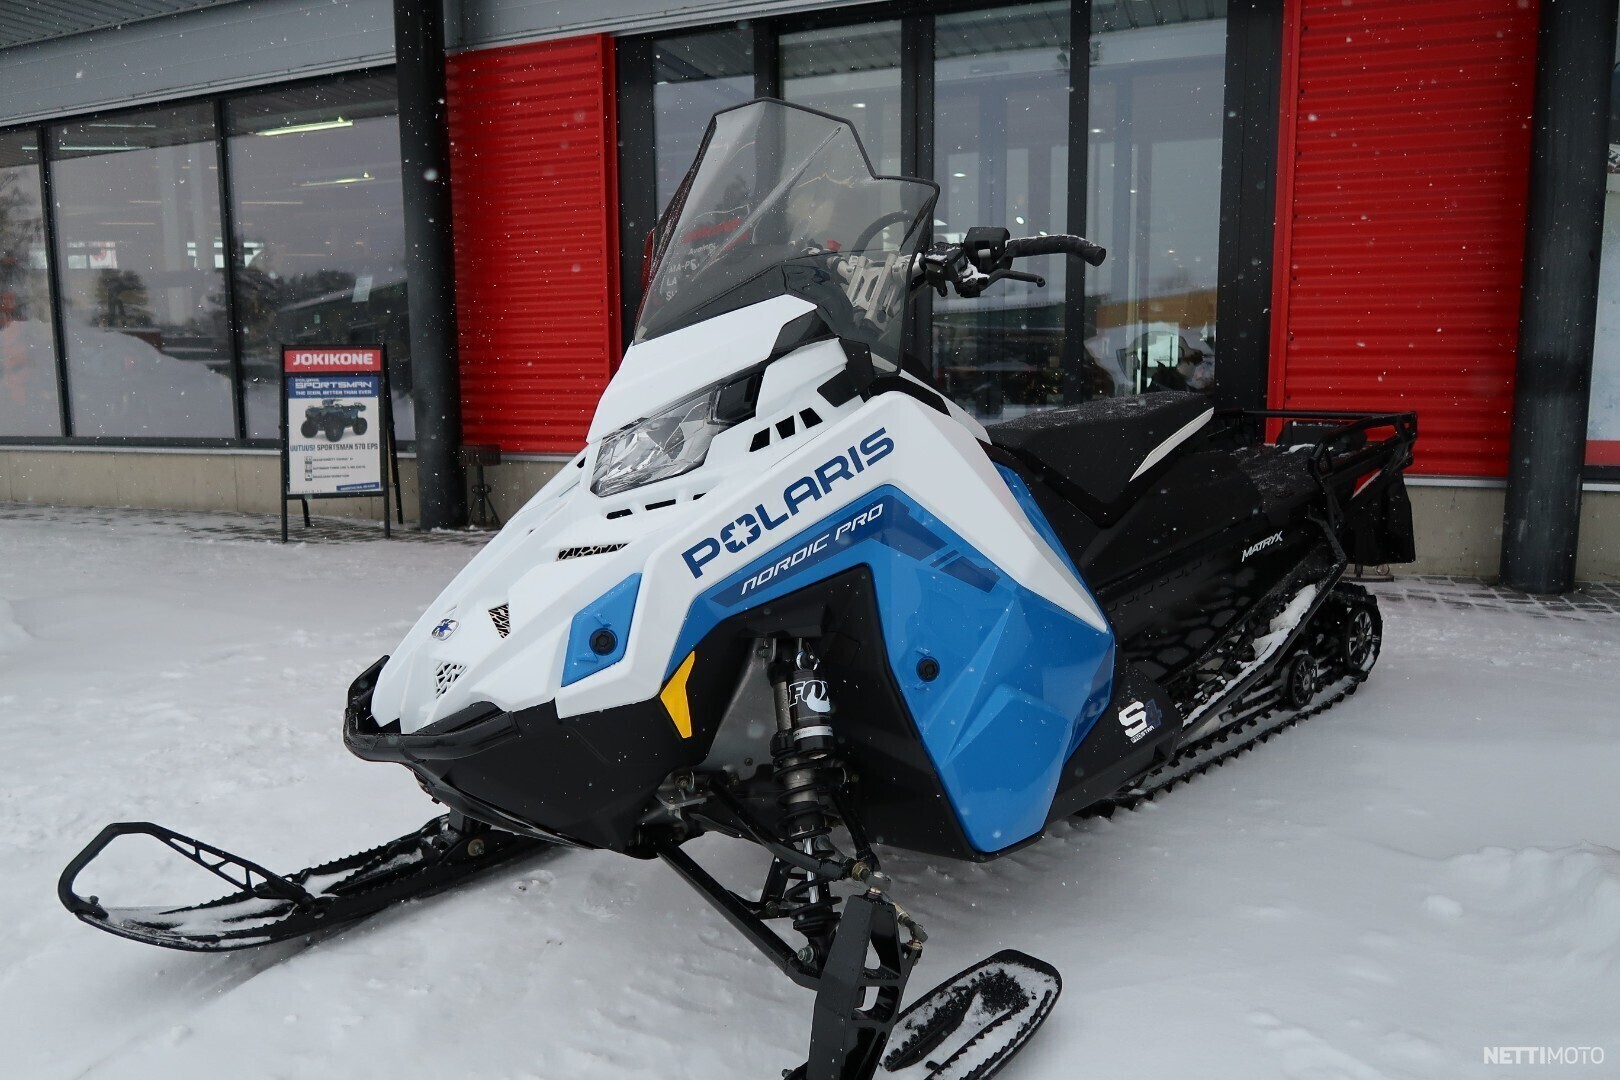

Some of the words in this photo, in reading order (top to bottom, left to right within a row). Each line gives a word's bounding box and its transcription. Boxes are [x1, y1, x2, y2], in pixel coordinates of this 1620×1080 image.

[293, 353, 373, 366] JOKIKONE
[295, 381, 372, 389] SPORTSMAN
[317, 443, 353, 451] SPORTSMAN
[681, 427, 895, 579] POLARIS
[834, 503, 884, 542] PRO
[788, 679, 831, 712] FOX
